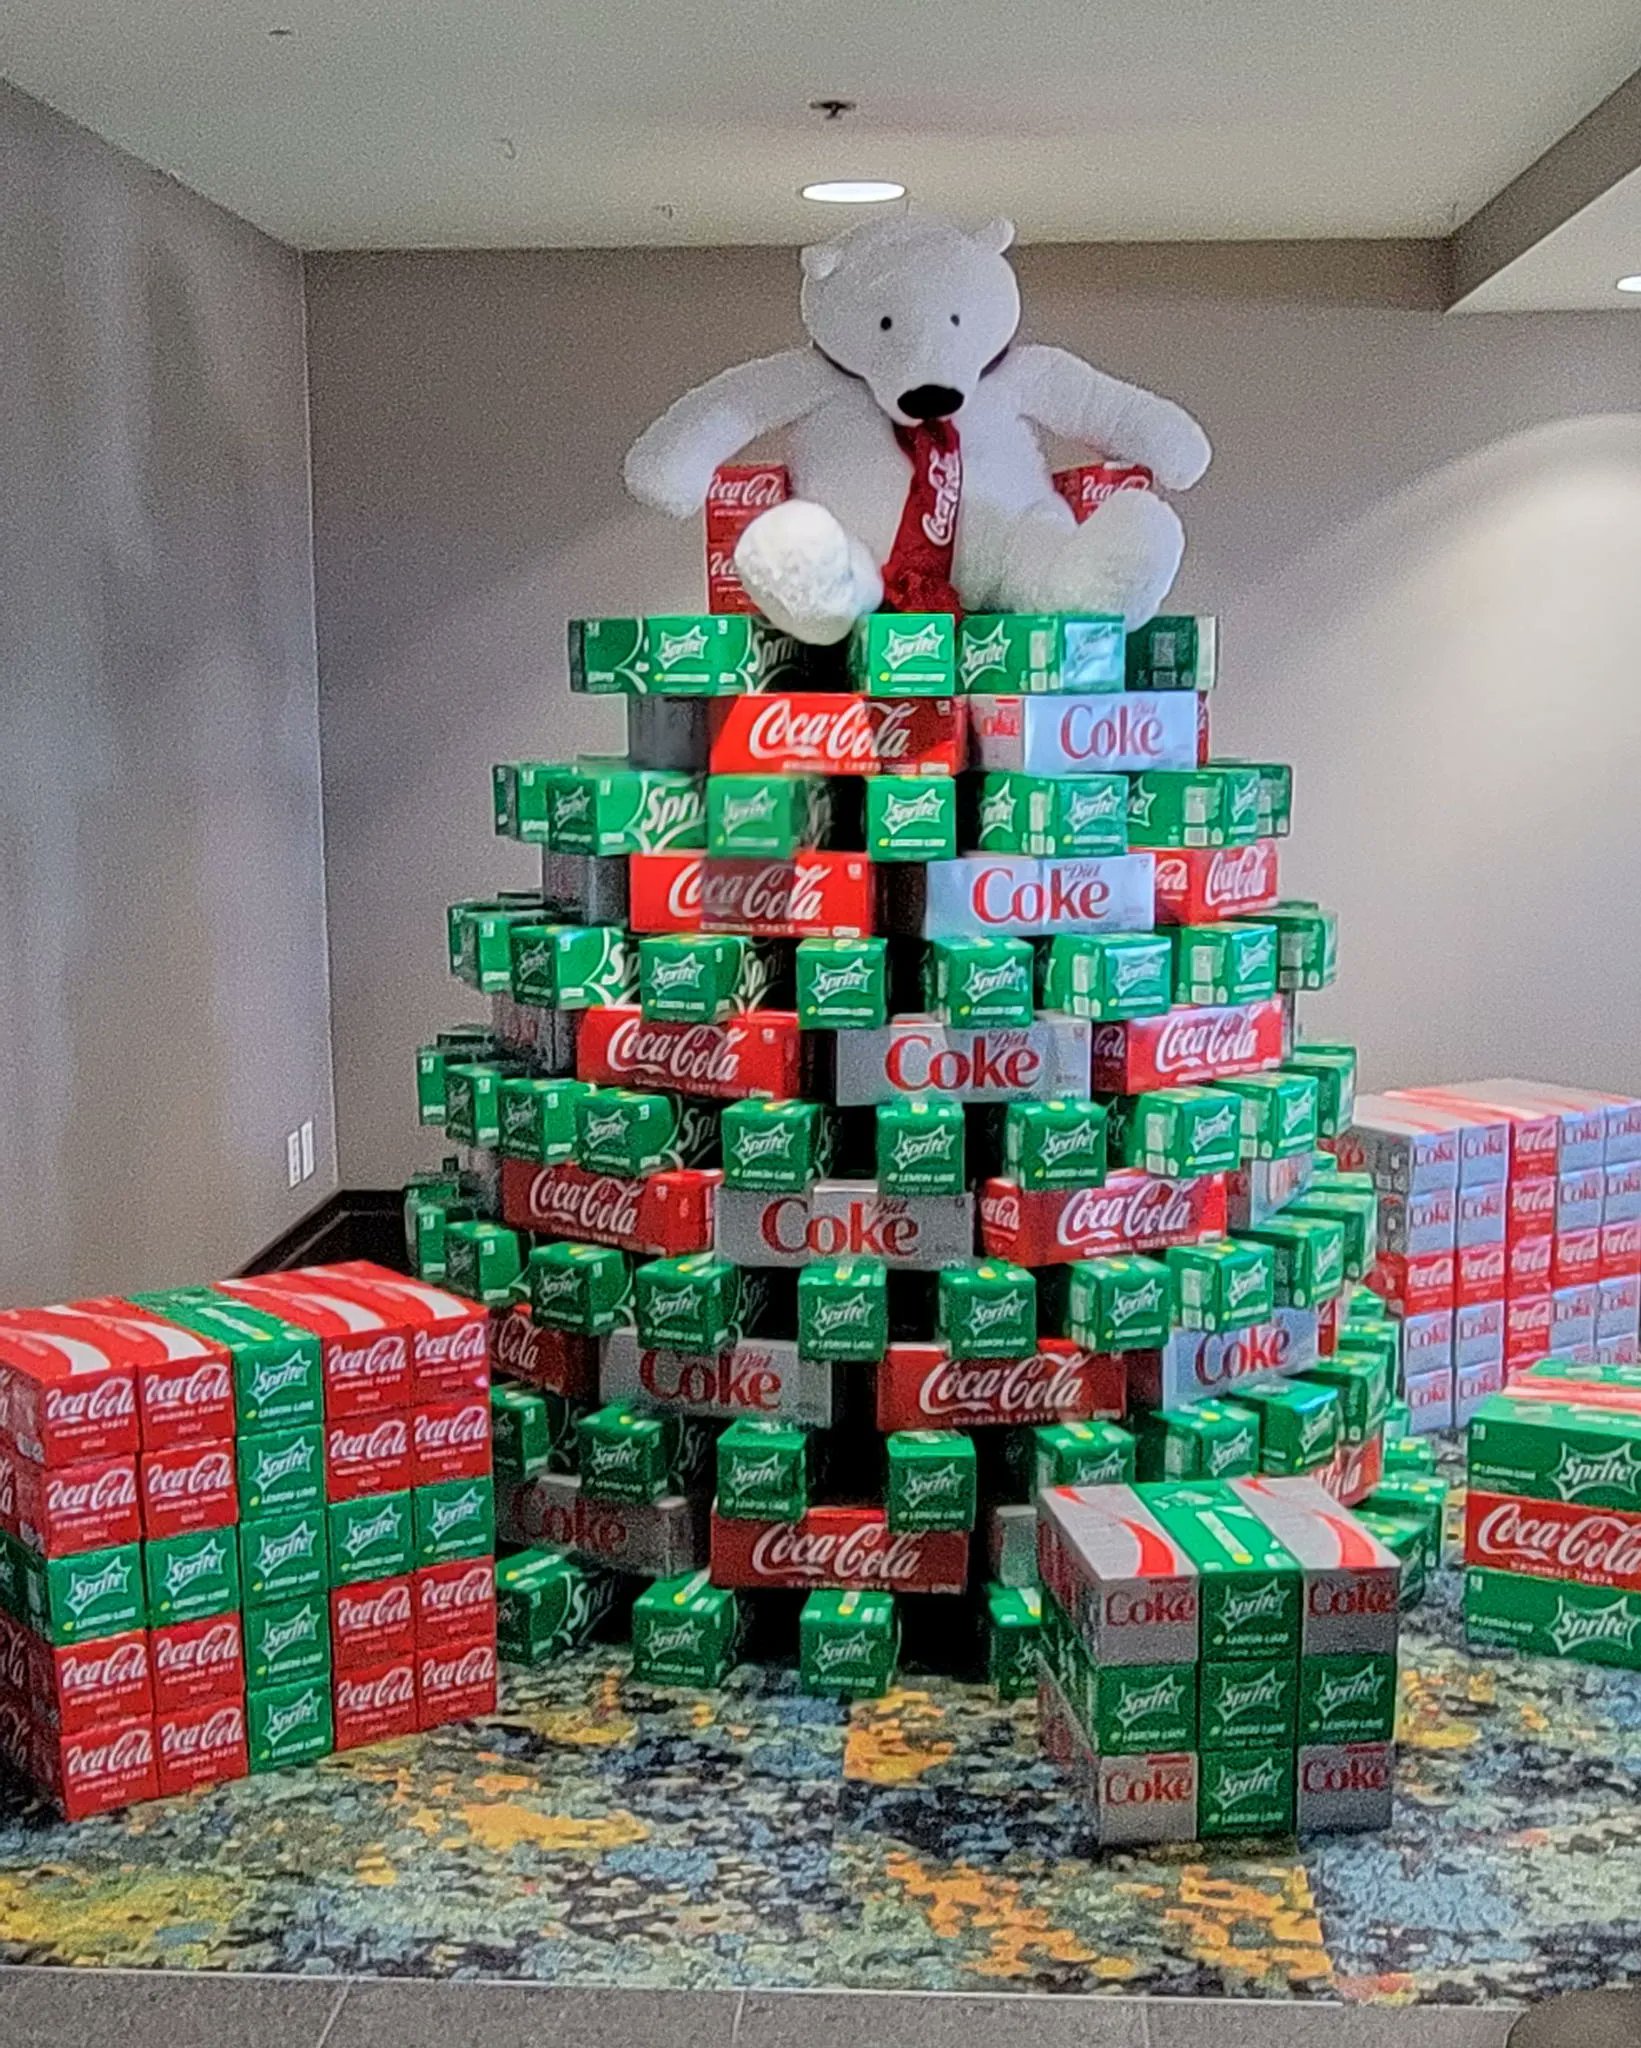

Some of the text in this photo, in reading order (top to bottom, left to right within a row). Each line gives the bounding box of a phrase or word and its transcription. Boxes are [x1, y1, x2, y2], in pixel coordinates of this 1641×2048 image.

[923, 449, 960, 546] Coca-Cola
[749, 699, 918, 759] Coca-Cola
[1061, 704, 1164, 760] Coke
[668, 858, 831, 919] Coca-Cola
[971, 868, 1110, 924] Coke
[1205, 842, 1272, 906] Coca-Cola
[606, 1019, 748, 1081] Coca-Cola
[885, 1035, 1039, 1091] Coke
[1156, 1011, 1258, 1073] Coca-Cola
[531, 1166, 642, 1234] Coca-Cola
[760, 1198, 919, 1255] Coke
[1058, 1180, 1192, 1246] Coca-Cola
[640, 1347, 781, 1410] Coke
[919, 1353, 1083, 1415] Coca-Cola
[1195, 1328, 1290, 1386] Coke
[753, 1523, 925, 1580] Coca-Cola
[1478, 1502, 1641, 1575] Coca-Cola
[1105, 1590, 1196, 1625] Coke
[1308, 1575, 1397, 1617] Coke
[1106, 1772, 1193, 1805] Coke
[1303, 1758, 1391, 1793] Coke
